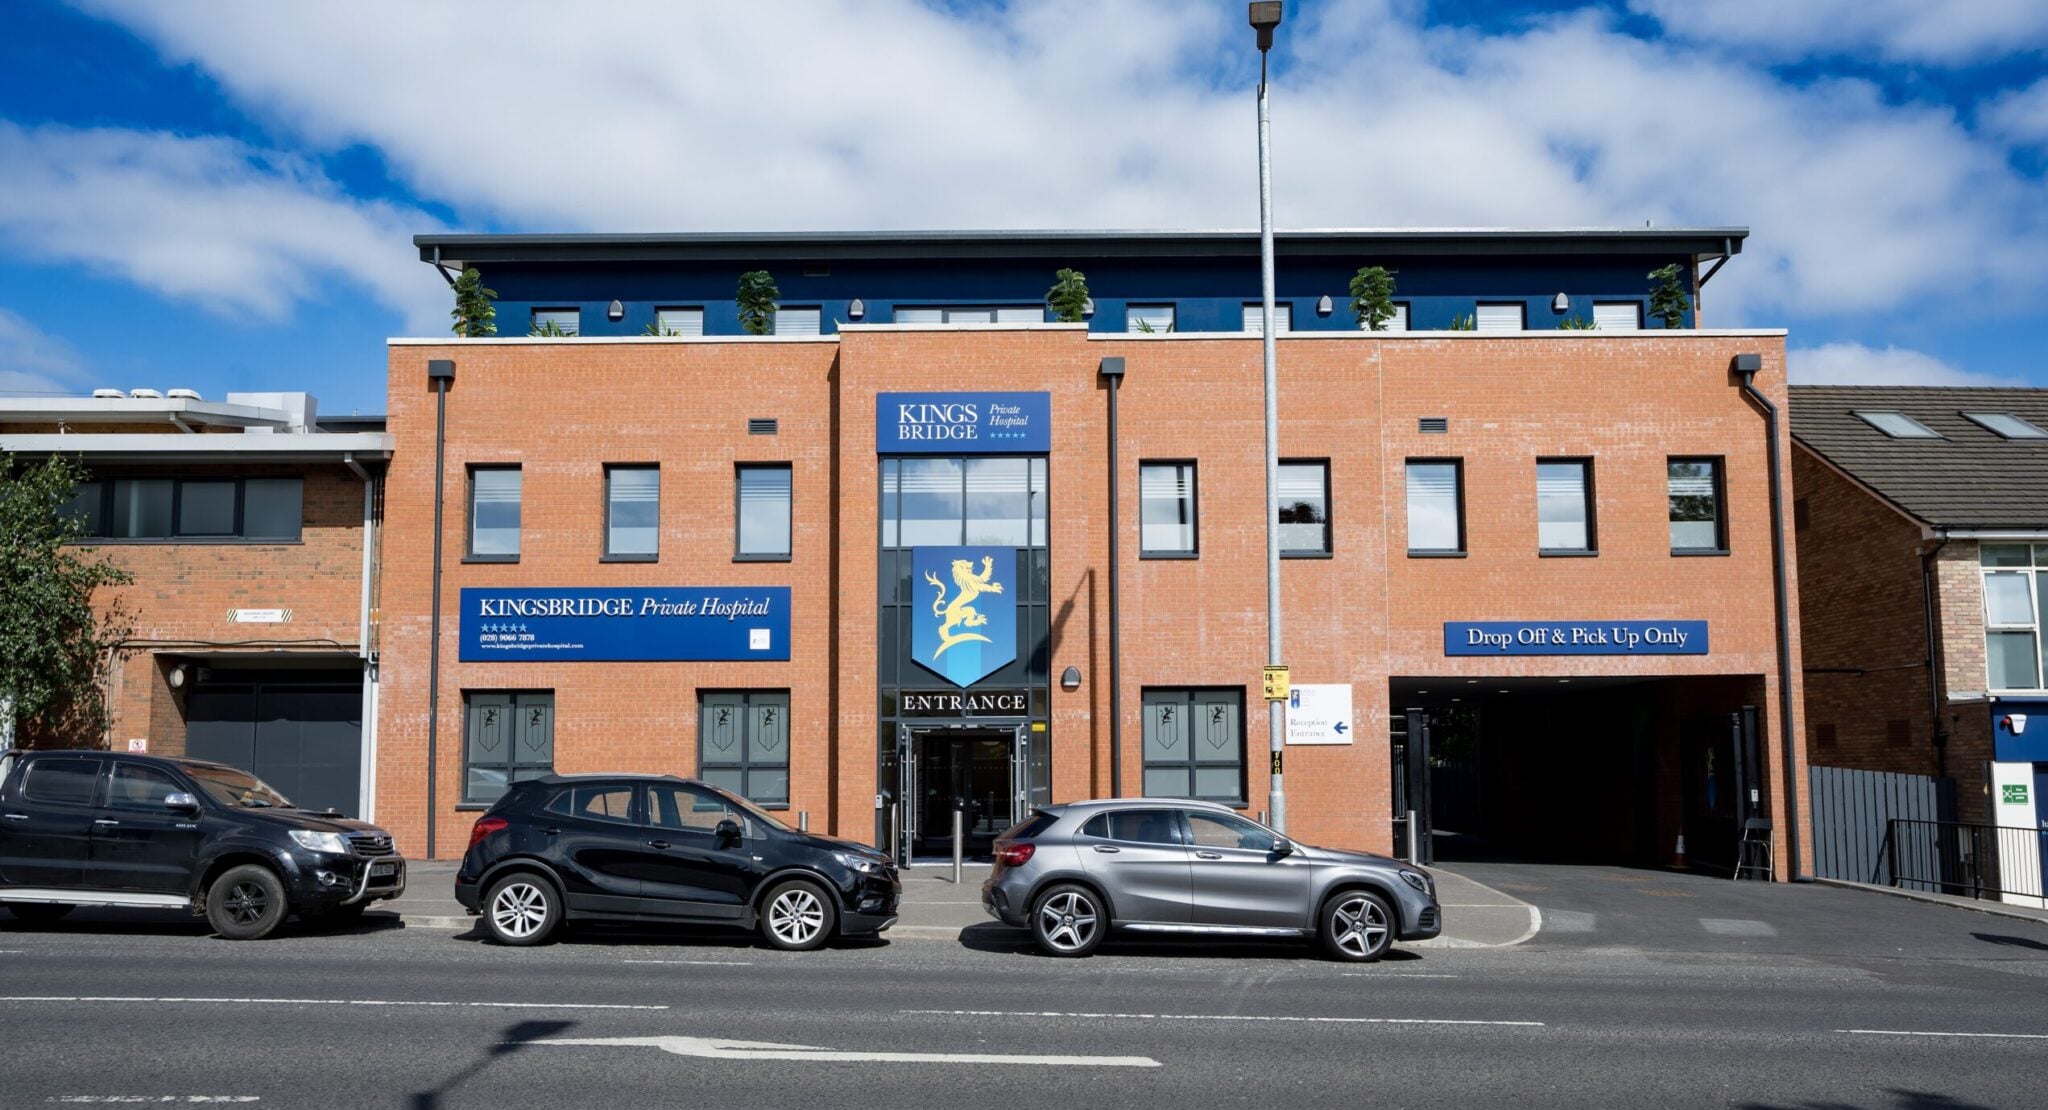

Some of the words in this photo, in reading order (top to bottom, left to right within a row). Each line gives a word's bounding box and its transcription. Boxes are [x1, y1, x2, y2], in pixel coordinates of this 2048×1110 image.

[898, 404, 978, 423] KINGS
[989, 403, 1021, 414] Private
[989, 415, 1030, 428] Hospital
[898, 424, 978, 439] BRIDGE
[480, 598, 633, 616] KINGSBRIDGE
[639, 598, 697, 616] Private
[699, 597, 770, 620] Hospital
[480, 634, 498, 643] (028)
[1467, 628, 1512, 648] Drop
[1517, 628, 1549, 645] Off
[1551, 629, 1567, 644] &
[1571, 627, 1608, 645] Pick
[1612, 628, 1639, 648] Up
[1644, 627, 1688, 647] Only
[903, 695, 1026, 710] ENTRANCE
[1290, 718, 1328, 728] Reception
[1290, 729, 1327, 737] Entrance
